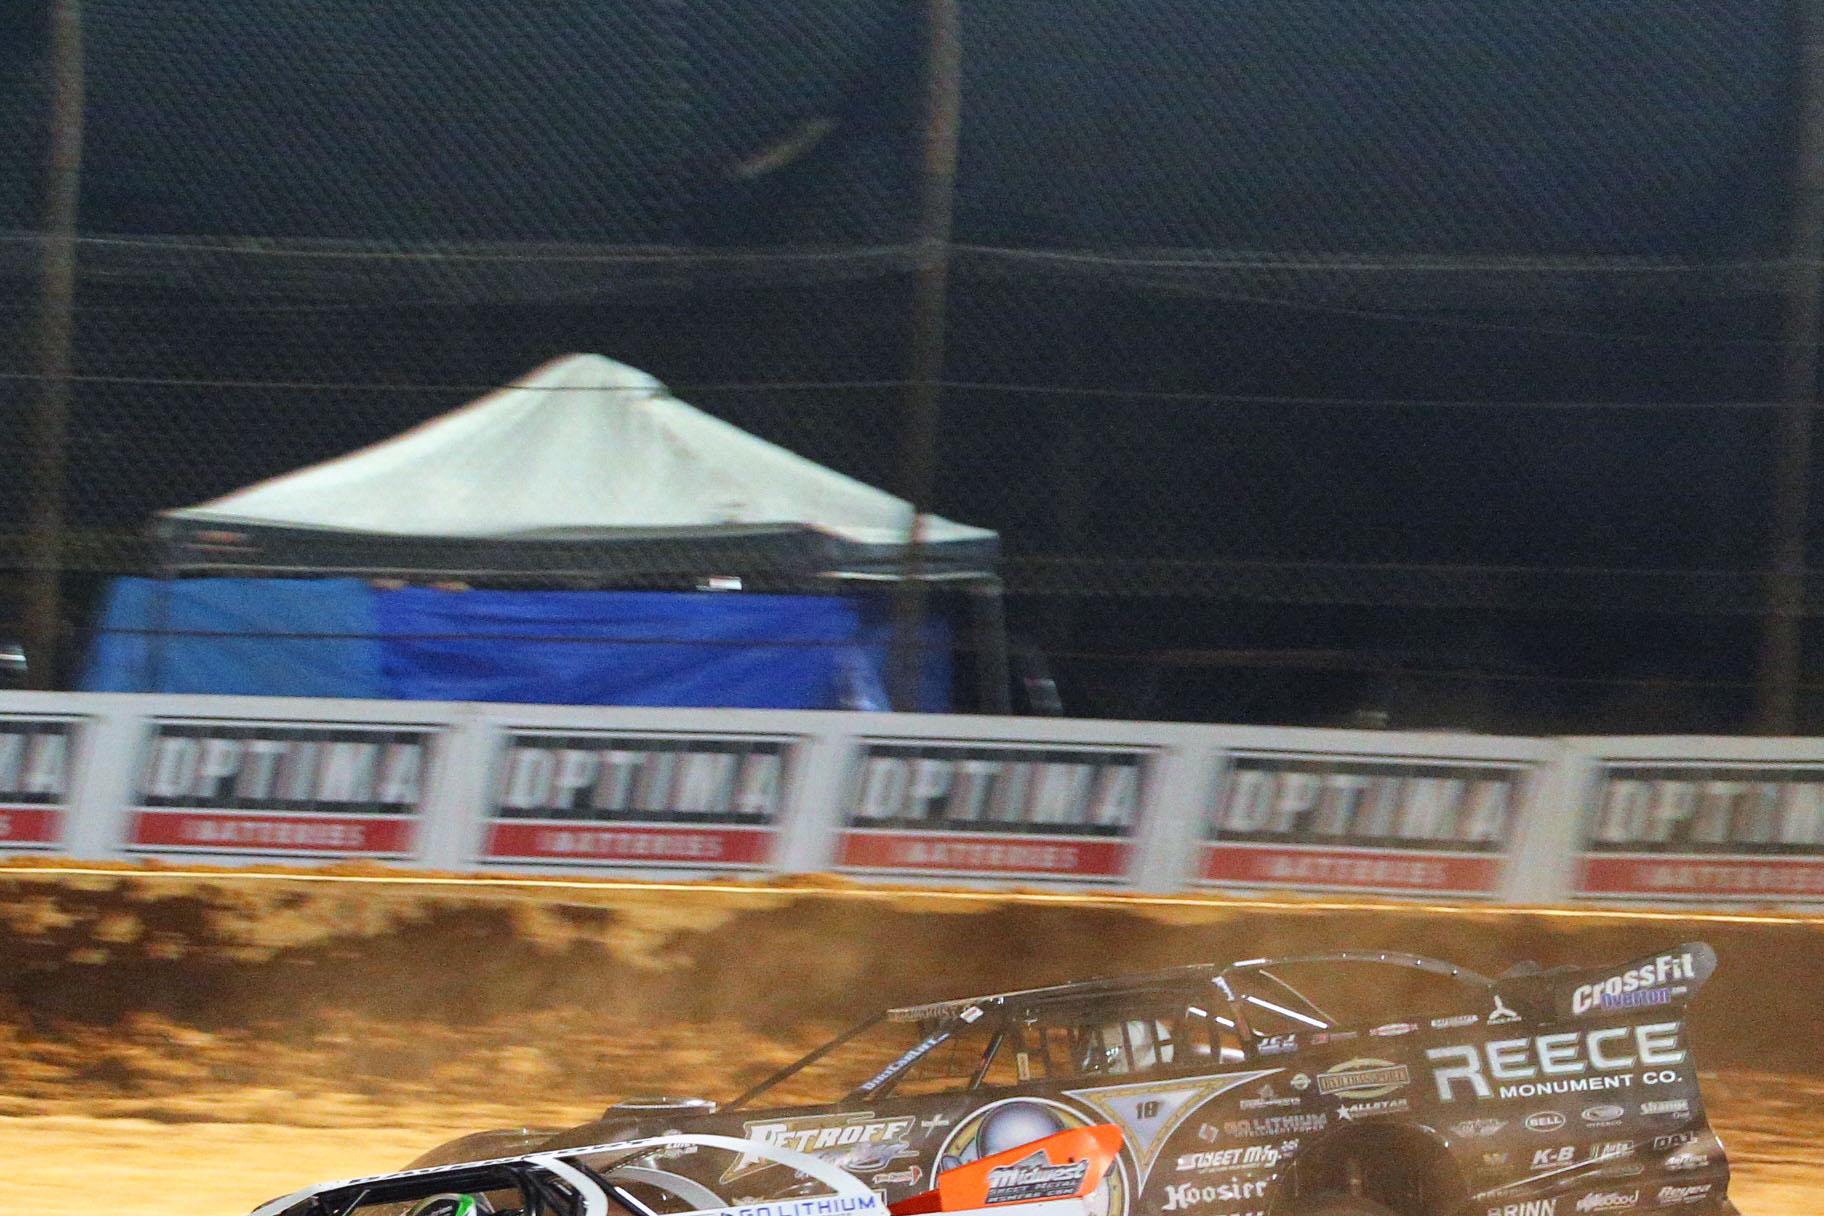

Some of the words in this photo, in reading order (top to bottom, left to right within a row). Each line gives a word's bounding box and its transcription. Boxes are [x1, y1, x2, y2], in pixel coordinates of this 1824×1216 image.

[144, 735, 424, 800] OPTIMA
[499, 745, 780, 813] OPTIMA
[863, 757, 1144, 827] OPTIMA
[1221, 768, 1514, 842] OPTIMA
[1572, 953, 1695, 1015] CrossFit
[1426, 1021, 1686, 1102] REECE
[1500, 1073, 1634, 1099] MONUMENT
[1643, 1070, 1683, 1086] CO.
[987, 1160, 1089, 1188] Midwest
[1161, 1176, 1267, 1211] Hoosier
